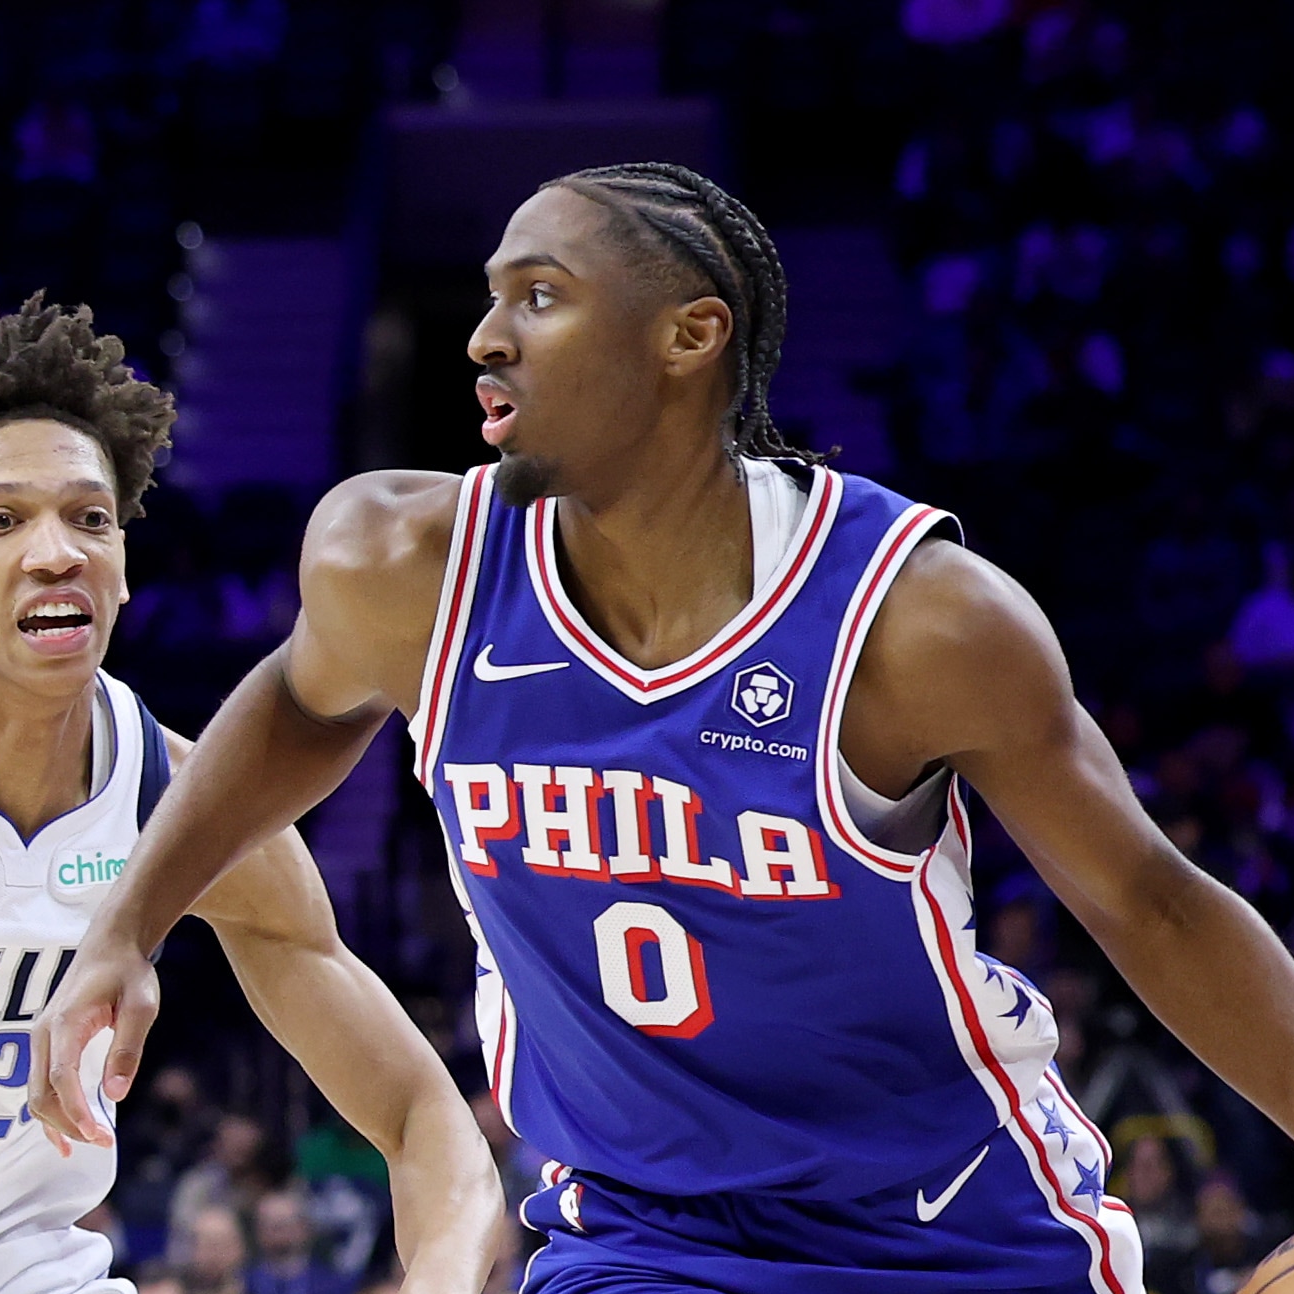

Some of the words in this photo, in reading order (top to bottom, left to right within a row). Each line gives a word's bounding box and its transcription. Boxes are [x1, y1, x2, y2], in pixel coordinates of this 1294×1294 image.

[700, 731, 807, 761] crypto.com
[58, 851, 127, 886] chim
[443, 762, 841, 901] PHILA
[593, 901, 714, 1039] 0
